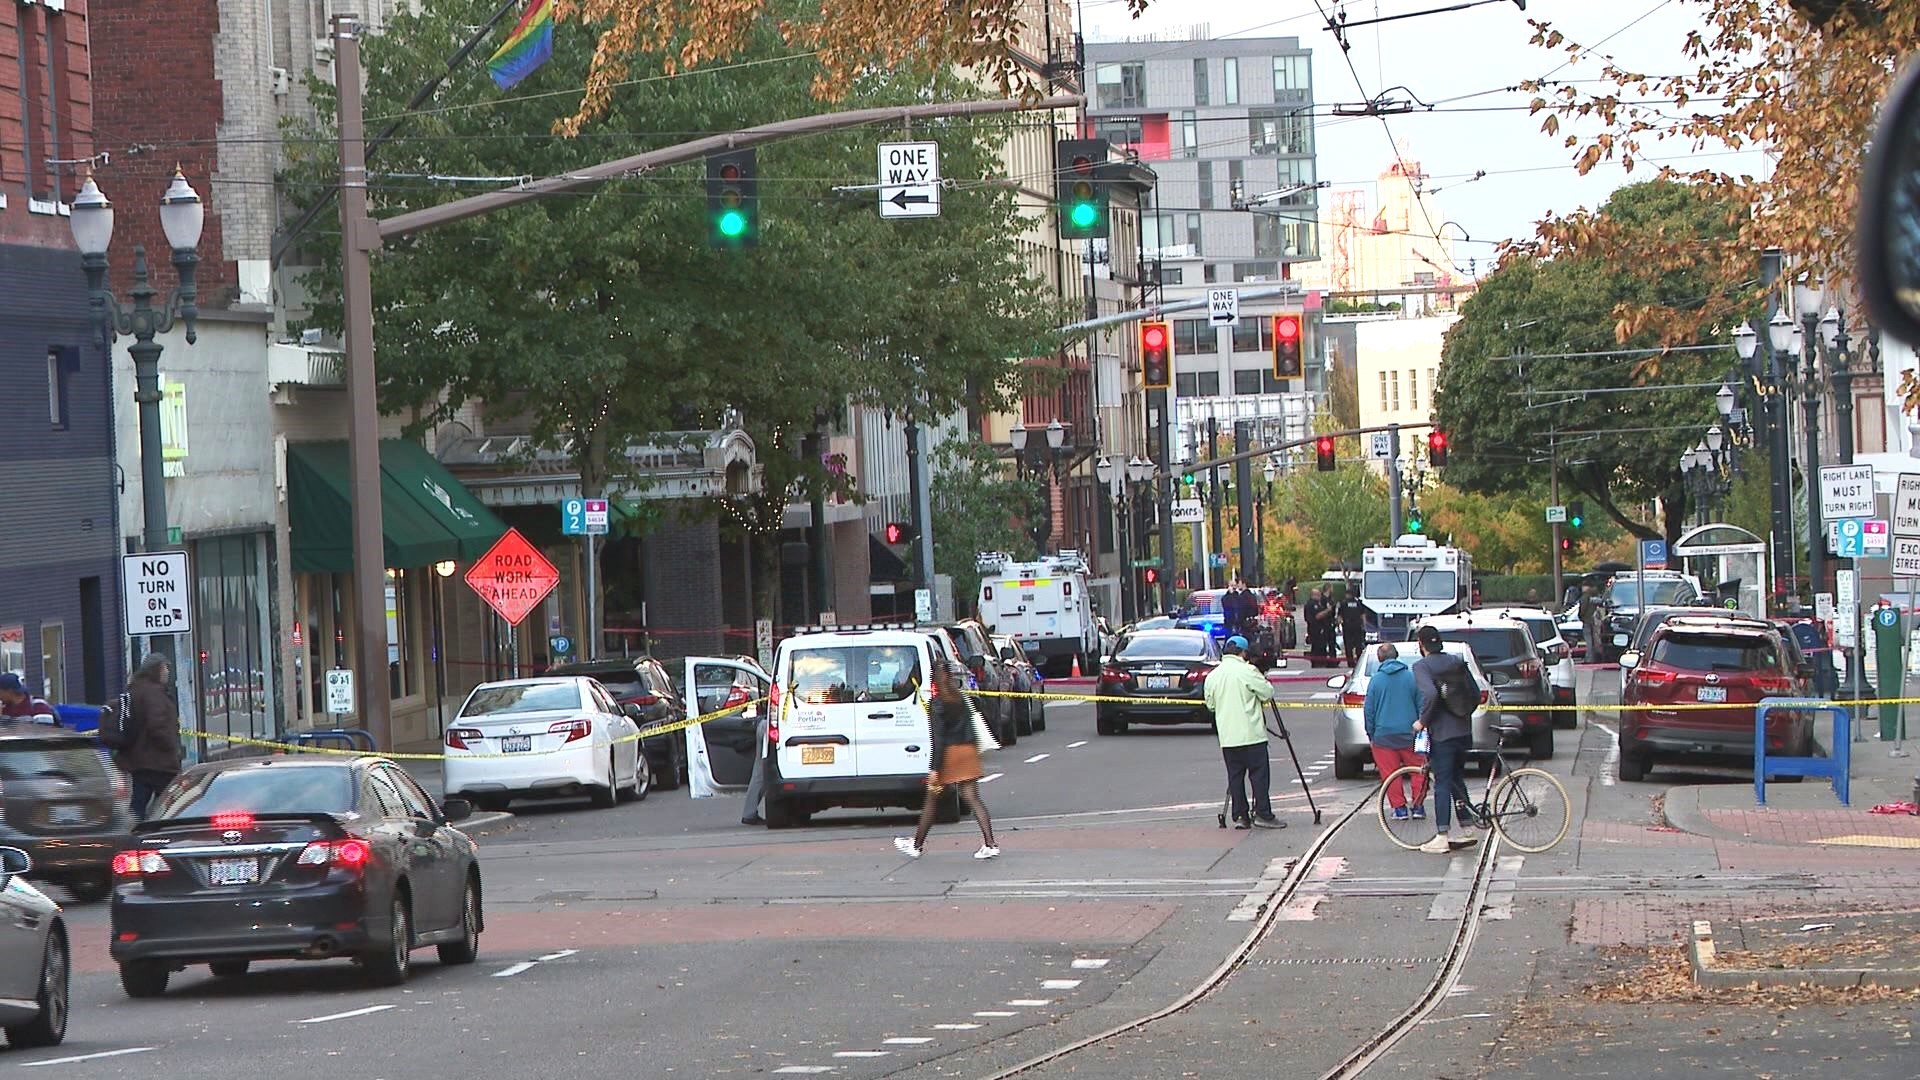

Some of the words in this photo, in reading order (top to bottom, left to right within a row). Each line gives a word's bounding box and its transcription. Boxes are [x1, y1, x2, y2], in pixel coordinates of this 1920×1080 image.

[890, 149, 927, 166] ONE
[889, 168, 929, 185] WAY
[1212, 290, 1233, 301] ONE
[1213, 301, 1234, 311] WAY
[1823, 472, 1846, 481] RIGHT
[1849, 470, 1871, 480] LANE
[1833, 486, 1862, 497] MUST
[1825, 503, 1846, 512] TURN
[1849, 501, 1872, 511] RIGHT
[570, 516, 580, 529] 2
[1897, 516, 1919, 528] TURN
[1846, 538, 1856, 551] 2
[495, 555, 532, 567] ROAD
[142, 560, 169, 576] NO
[495, 571, 532, 584] WORK
[138, 580, 175, 594] TURN
[492, 588, 537, 600] AHEAD
[148, 597, 167, 611] ON
[145, 614, 172, 628] RED
